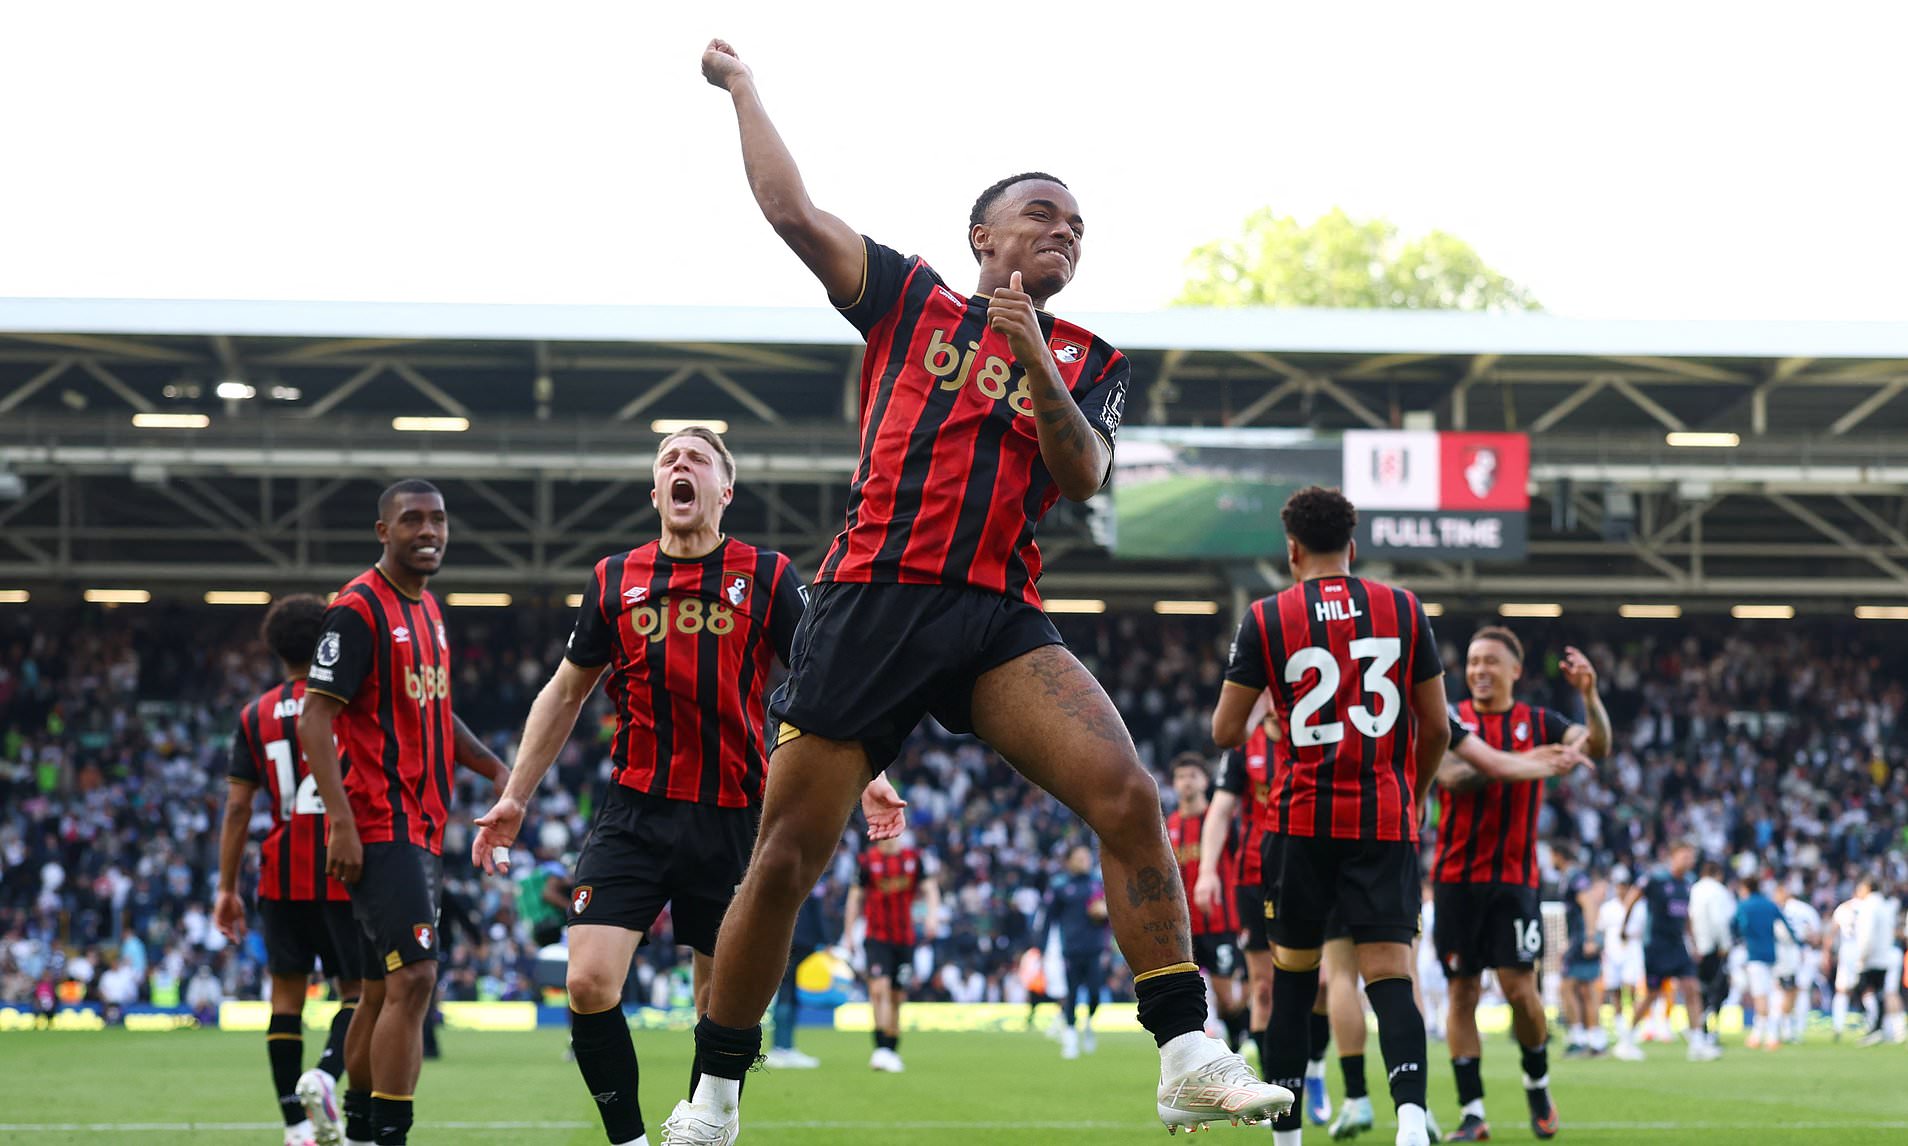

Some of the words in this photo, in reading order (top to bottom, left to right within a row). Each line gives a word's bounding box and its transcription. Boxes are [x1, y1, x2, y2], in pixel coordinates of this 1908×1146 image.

[923, 329, 1035, 417] bj88
[1371, 516, 1437, 547] FULL
[1436, 517, 1502, 548] TIME
[631, 596, 735, 643] bj88
[1314, 597, 1362, 622] HILL
[404, 665, 449, 707] bj88
[1284, 637, 1401, 747] 23
[1514, 918, 1541, 952] 16
